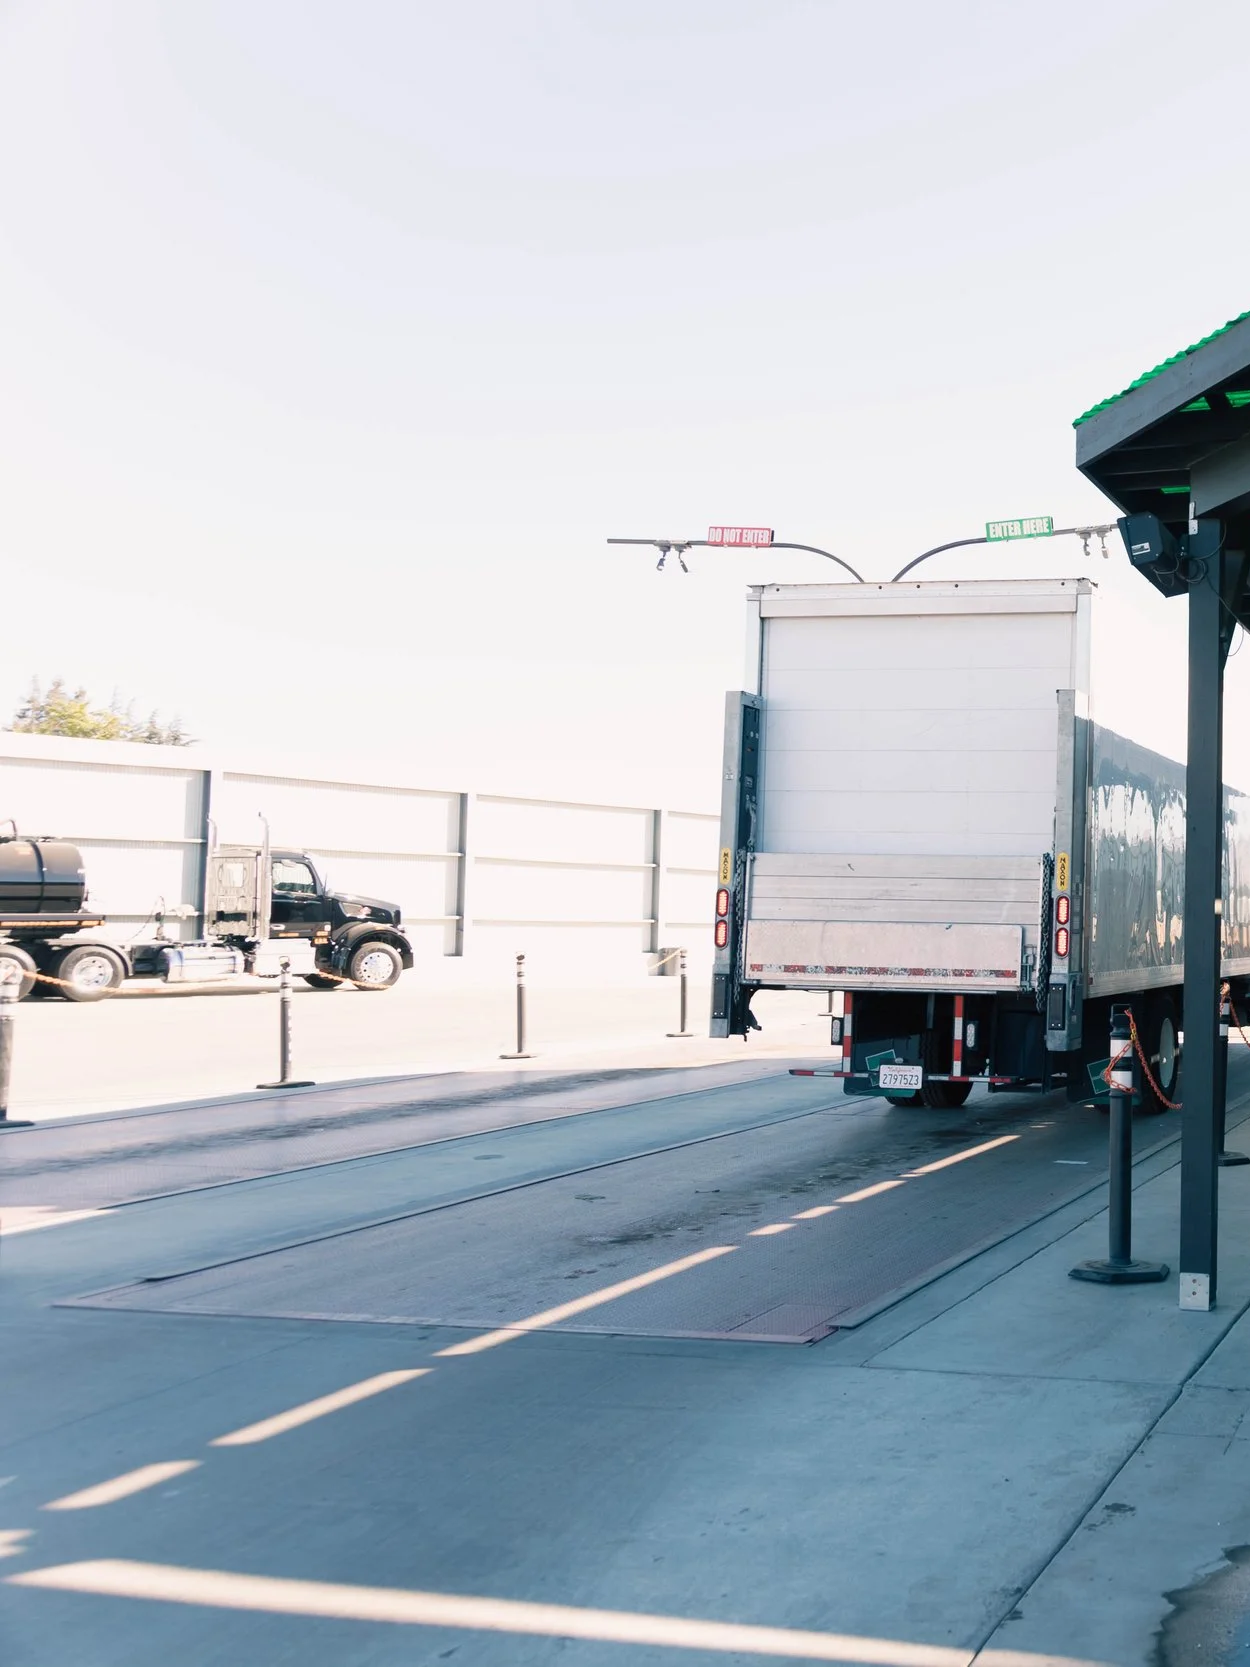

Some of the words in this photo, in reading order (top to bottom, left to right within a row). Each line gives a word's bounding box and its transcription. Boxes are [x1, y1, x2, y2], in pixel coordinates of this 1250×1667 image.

[709, 528, 722, 543] DO
[723, 528, 742, 544] NOT
[742, 529, 769, 544] ENTER
[989, 521, 1021, 538] ENTER
[1022, 518, 1050, 535] HERE
